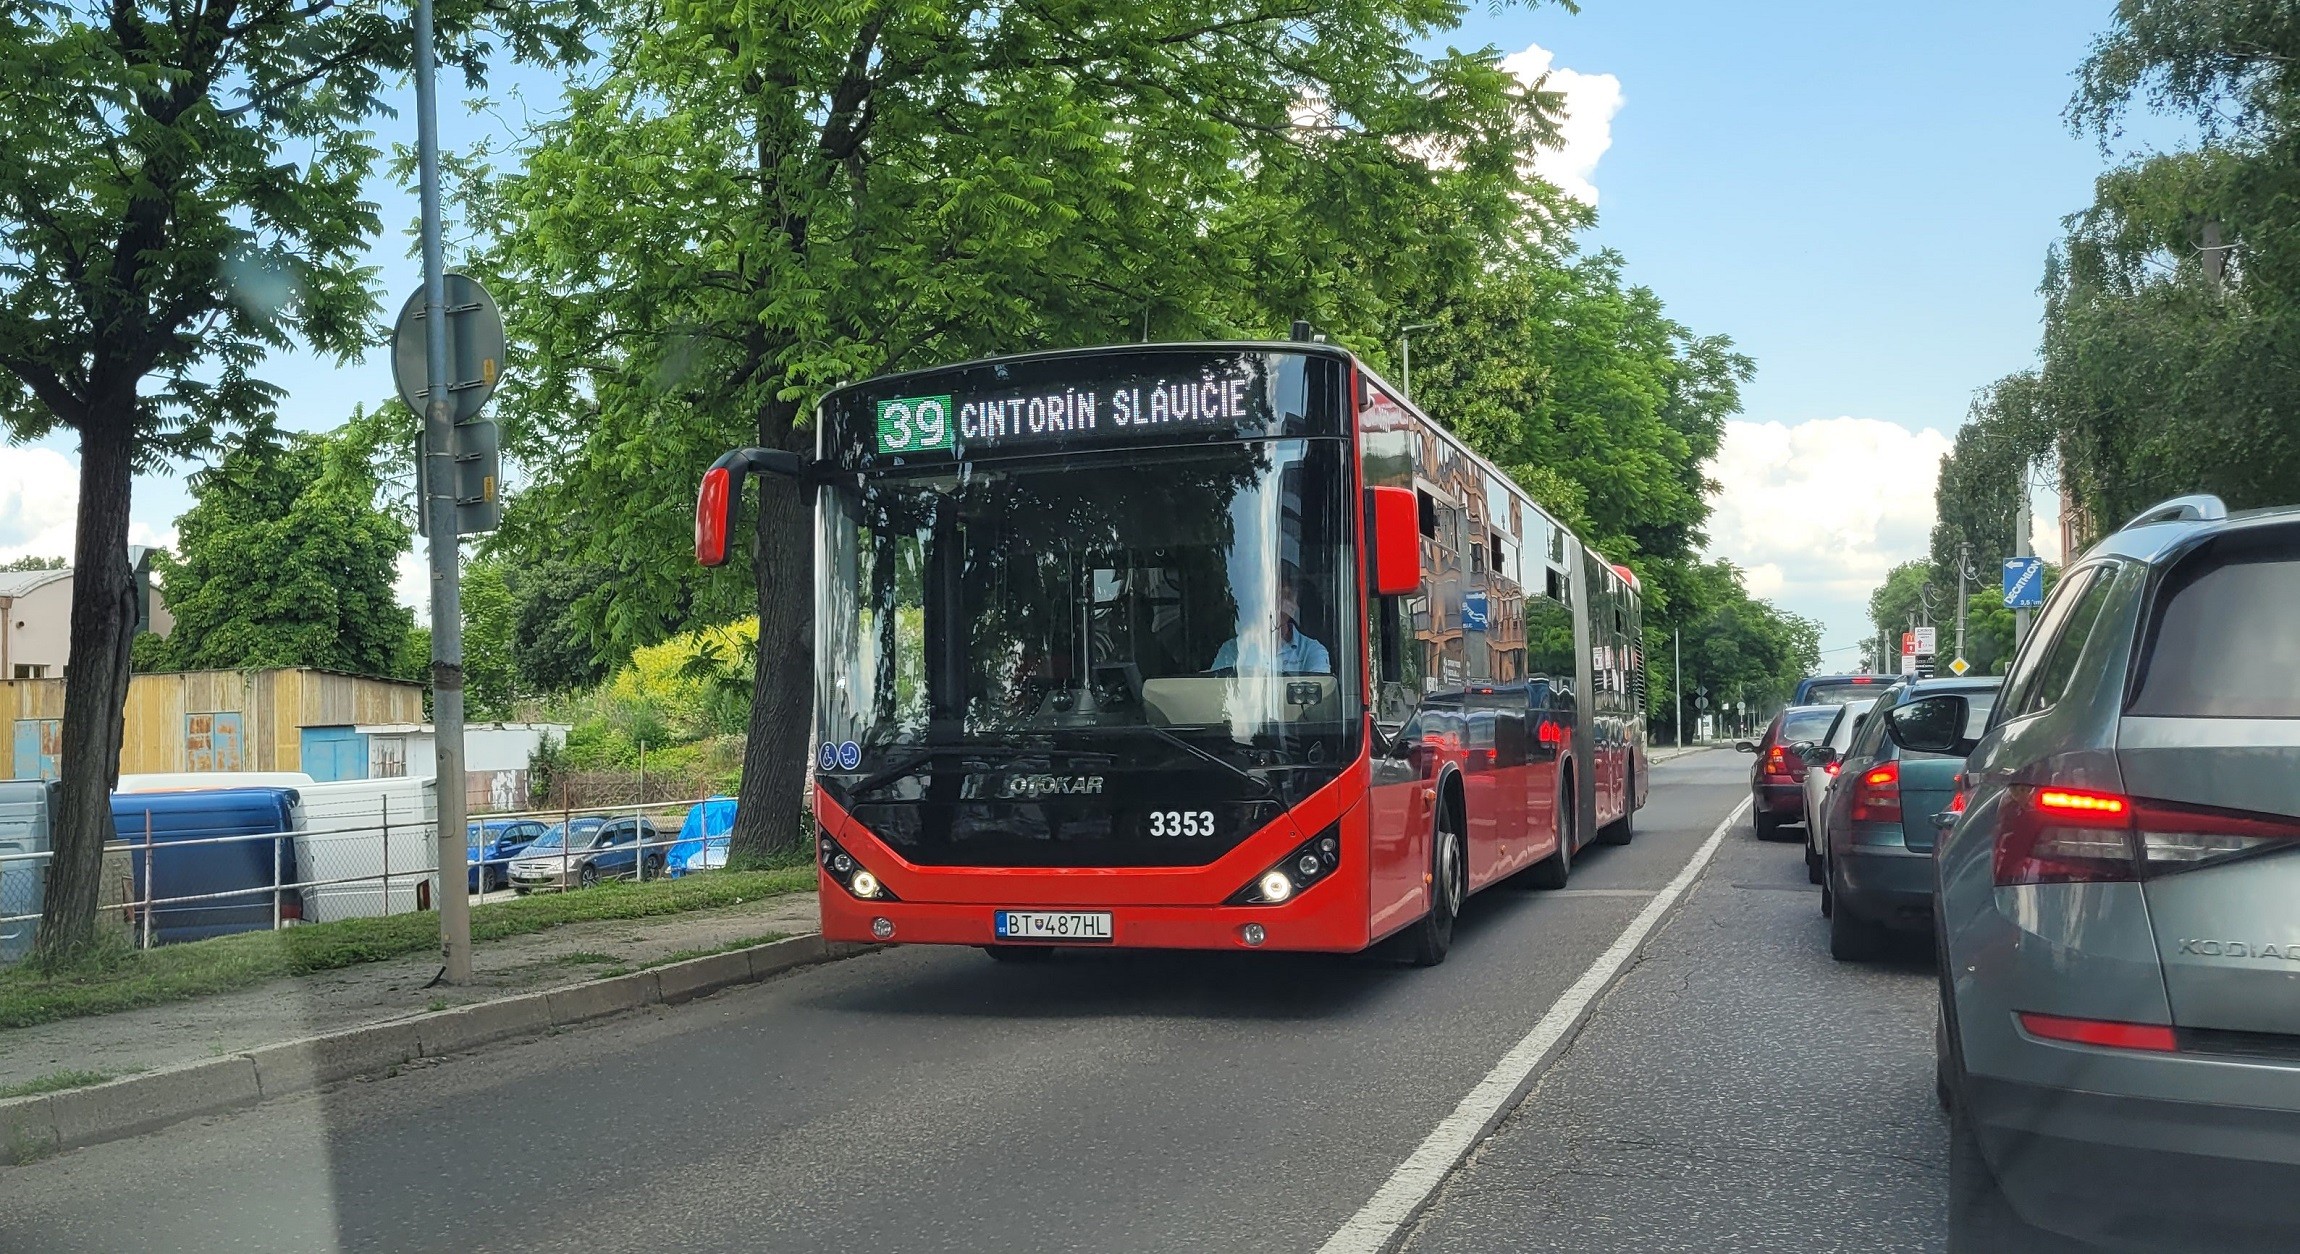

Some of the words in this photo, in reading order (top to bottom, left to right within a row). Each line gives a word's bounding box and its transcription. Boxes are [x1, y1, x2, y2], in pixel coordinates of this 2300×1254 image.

[883, 399, 946, 449] 39
[960, 387, 1096, 439] CINTORÍN
[1113, 375, 1247, 426] SLÁVIČIE
[2004, 560, 2042, 604] DECATHLON
[1010, 776, 1104, 795] OTOKAR
[1149, 811, 1215, 837] 3353
[1009, 914, 1032, 936] BT
[1045, 914, 1108, 936] 487HL
